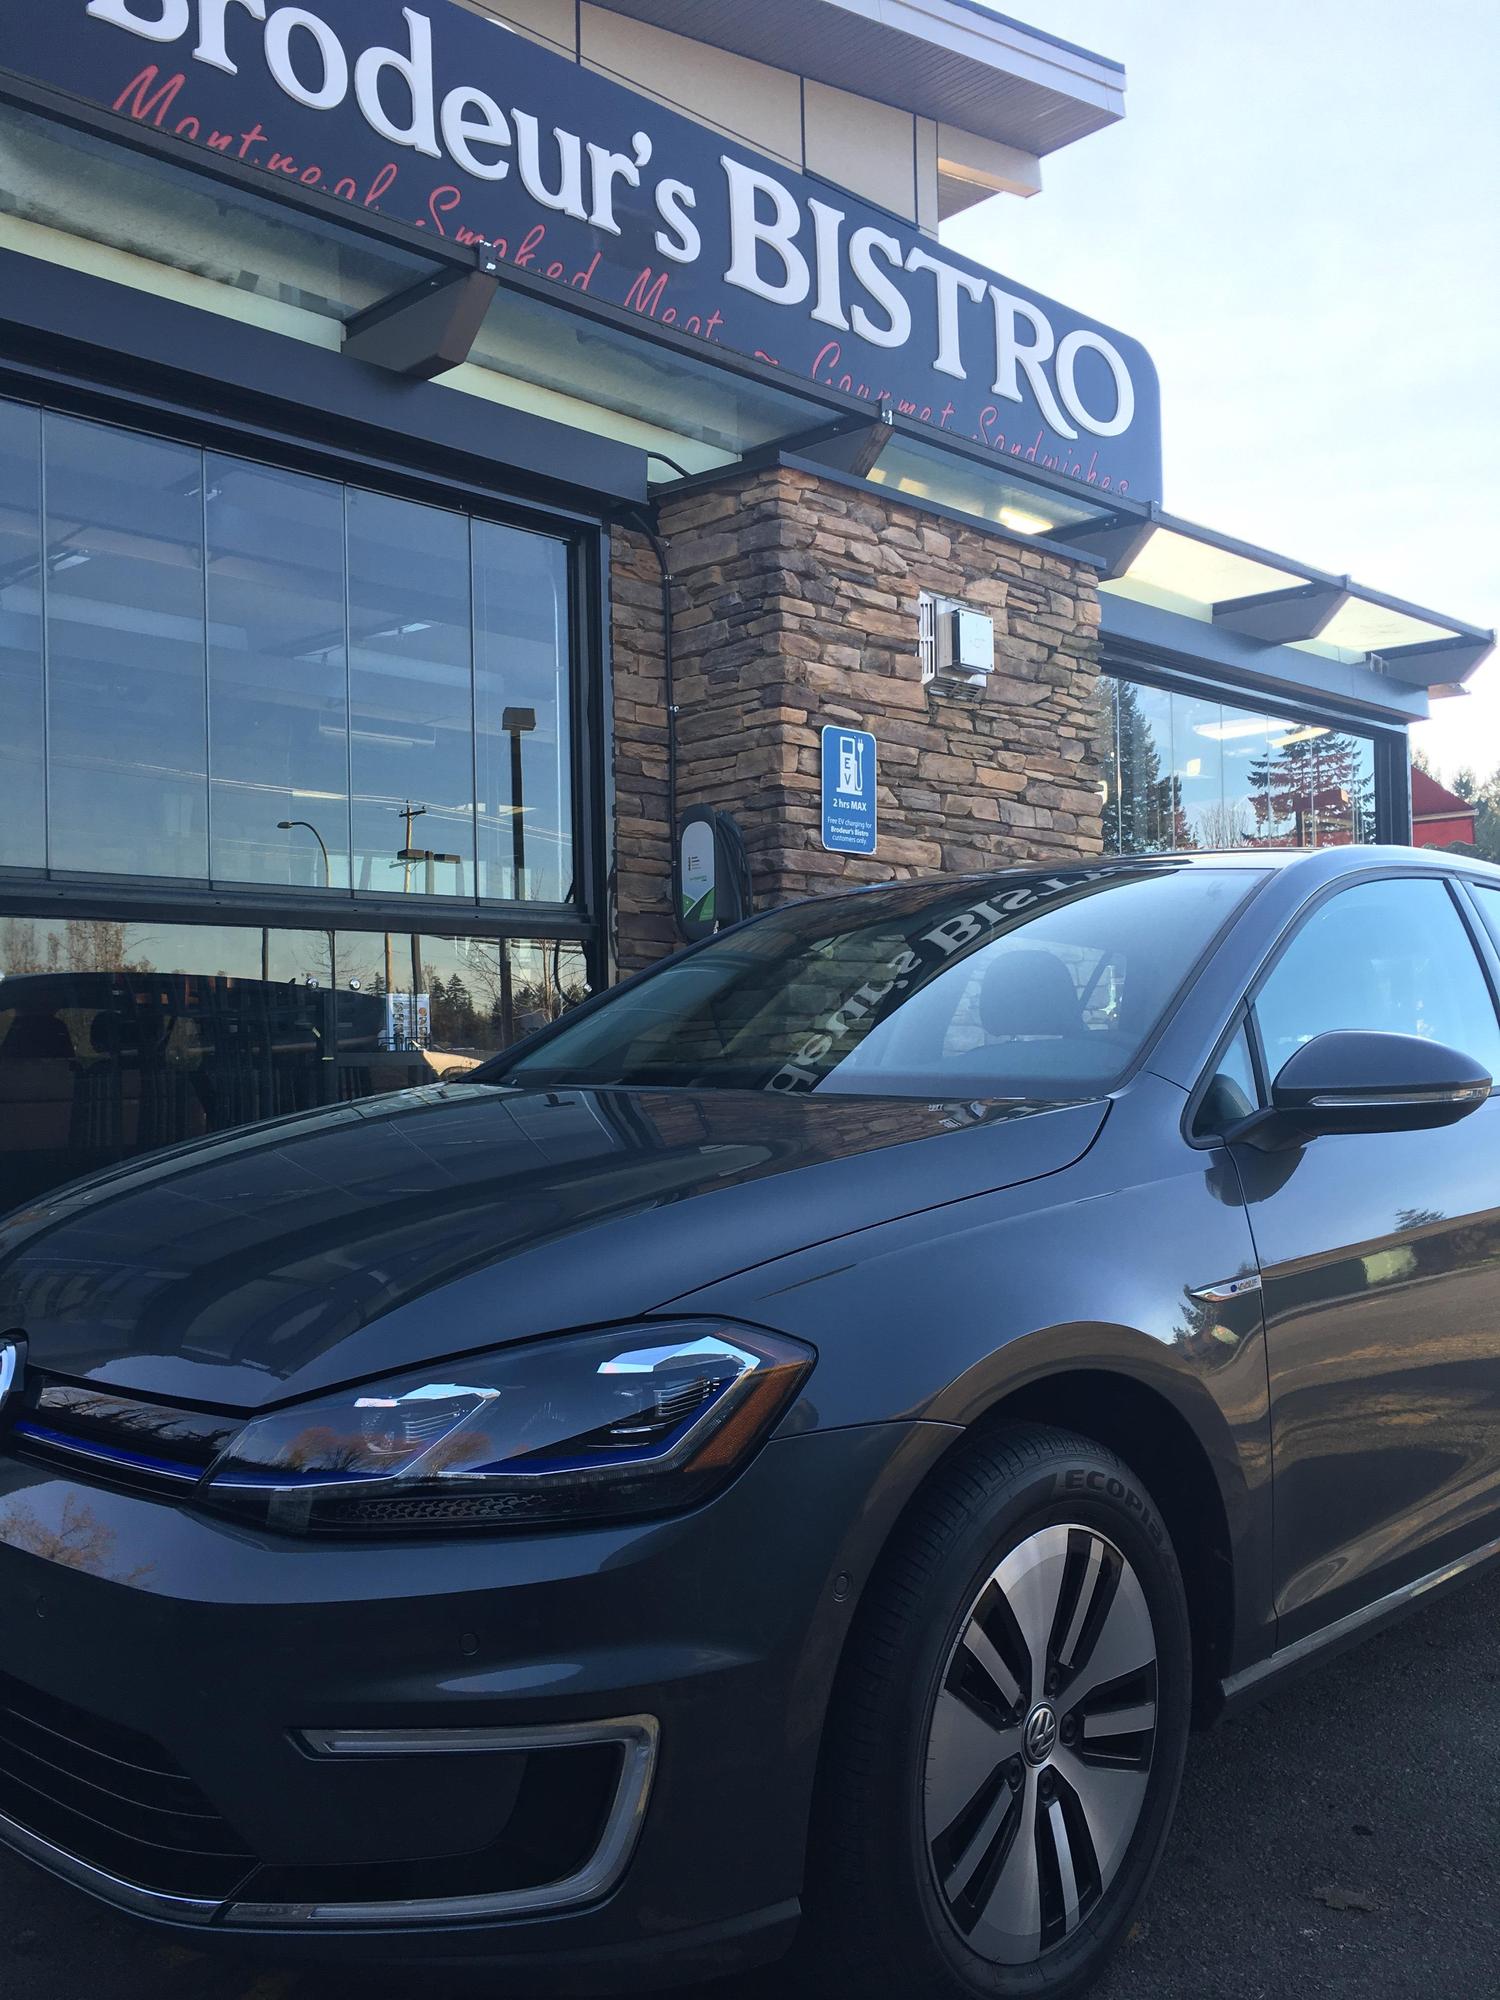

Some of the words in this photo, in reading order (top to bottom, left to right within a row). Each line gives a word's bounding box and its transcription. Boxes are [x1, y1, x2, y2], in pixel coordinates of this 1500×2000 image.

[85, 0, 700, 263] rodeur's
[719, 154, 1135, 441] BISTRO
[624, 267, 725, 342] Meat
[833, 798, 838, 807] 2
[839, 799, 850, 809] hrs
[851, 801, 867, 811] MAX
